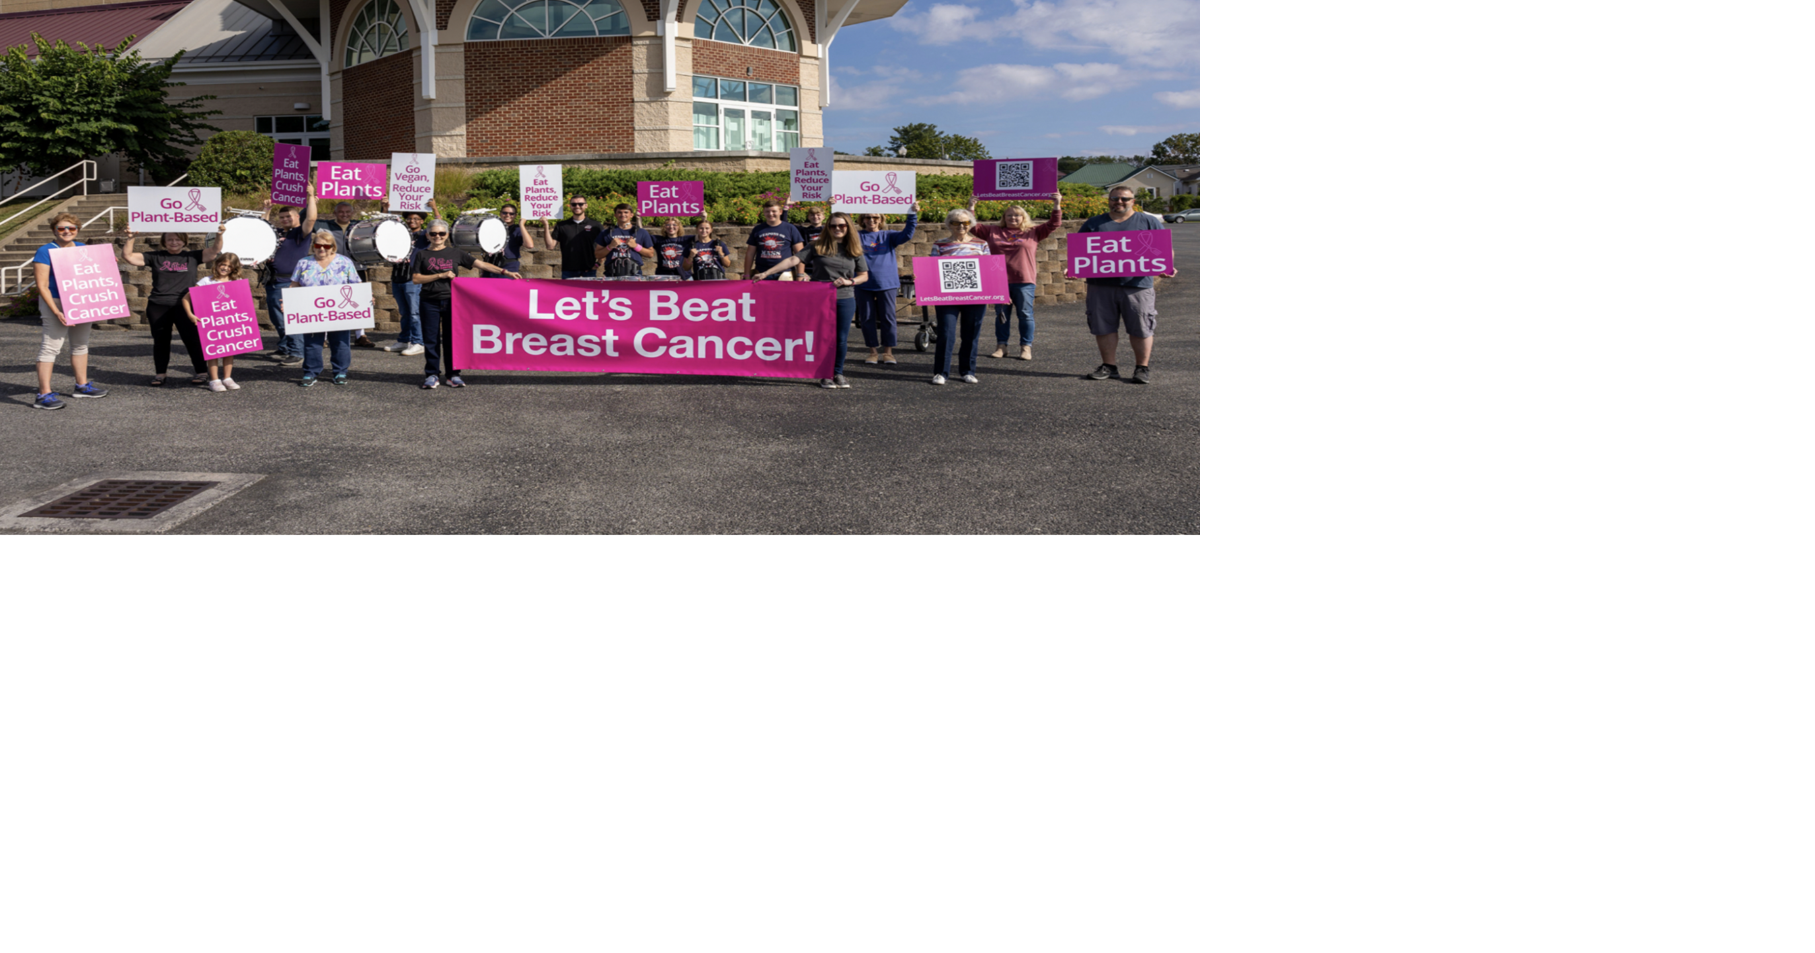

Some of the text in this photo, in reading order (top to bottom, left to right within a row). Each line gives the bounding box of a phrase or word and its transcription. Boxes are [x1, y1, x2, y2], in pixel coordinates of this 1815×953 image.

[283, 159, 299, 169] Eat
[405, 165, 420, 174] Go
[804, 160, 819, 169] Eat
[274, 168, 306, 182] Plants,
[330, 165, 362, 180] Eat
[394, 172, 430, 183] Vegan,
[796, 168, 828, 178] Plants,
[275, 180, 304, 192] Crush
[533, 178, 548, 187] Eat
[794, 176, 830, 184] Reduce
[859, 181, 880, 192] Go
[321, 181, 382, 197] Plants
[392, 184, 431, 193] Reduce
[525, 186, 555, 196] Plants,
[649, 184, 679, 198] Eat
[800, 184, 823, 192] Your
[271, 191, 307, 205] Cancer
[398, 192, 424, 201] Your
[524, 193, 558, 202] Reduce
[802, 191, 822, 199] Risk
[834, 193, 913, 205] Plant-Based
[160, 197, 183, 210] Go
[399, 201, 421, 210] Risk
[530, 202, 552, 210] Your
[641, 199, 700, 215] Plants
[131, 211, 218, 224] Plant-Based
[532, 209, 551, 217] Risk
[1086, 236, 1132, 254] Eat
[73, 263, 102, 276] Eat
[1074, 255, 1167, 274] Plants
[61, 274, 119, 293] Plants,
[68, 289, 119, 306] Crush
[314, 296, 336, 309] Go
[920, 294, 1005, 303] LetsBeatBreastCancer.org
[67, 302, 126, 321] Cancer
[211, 299, 237, 312] Eat
[528, 289, 756, 322] Let’s Beat
[200, 311, 253, 329] Plants,
[287, 307, 371, 324] Plant-Based
[206, 325, 253, 341] Crush
[205, 338, 260, 356] Cancer
[472, 324, 815, 362] Breast Cancer!
